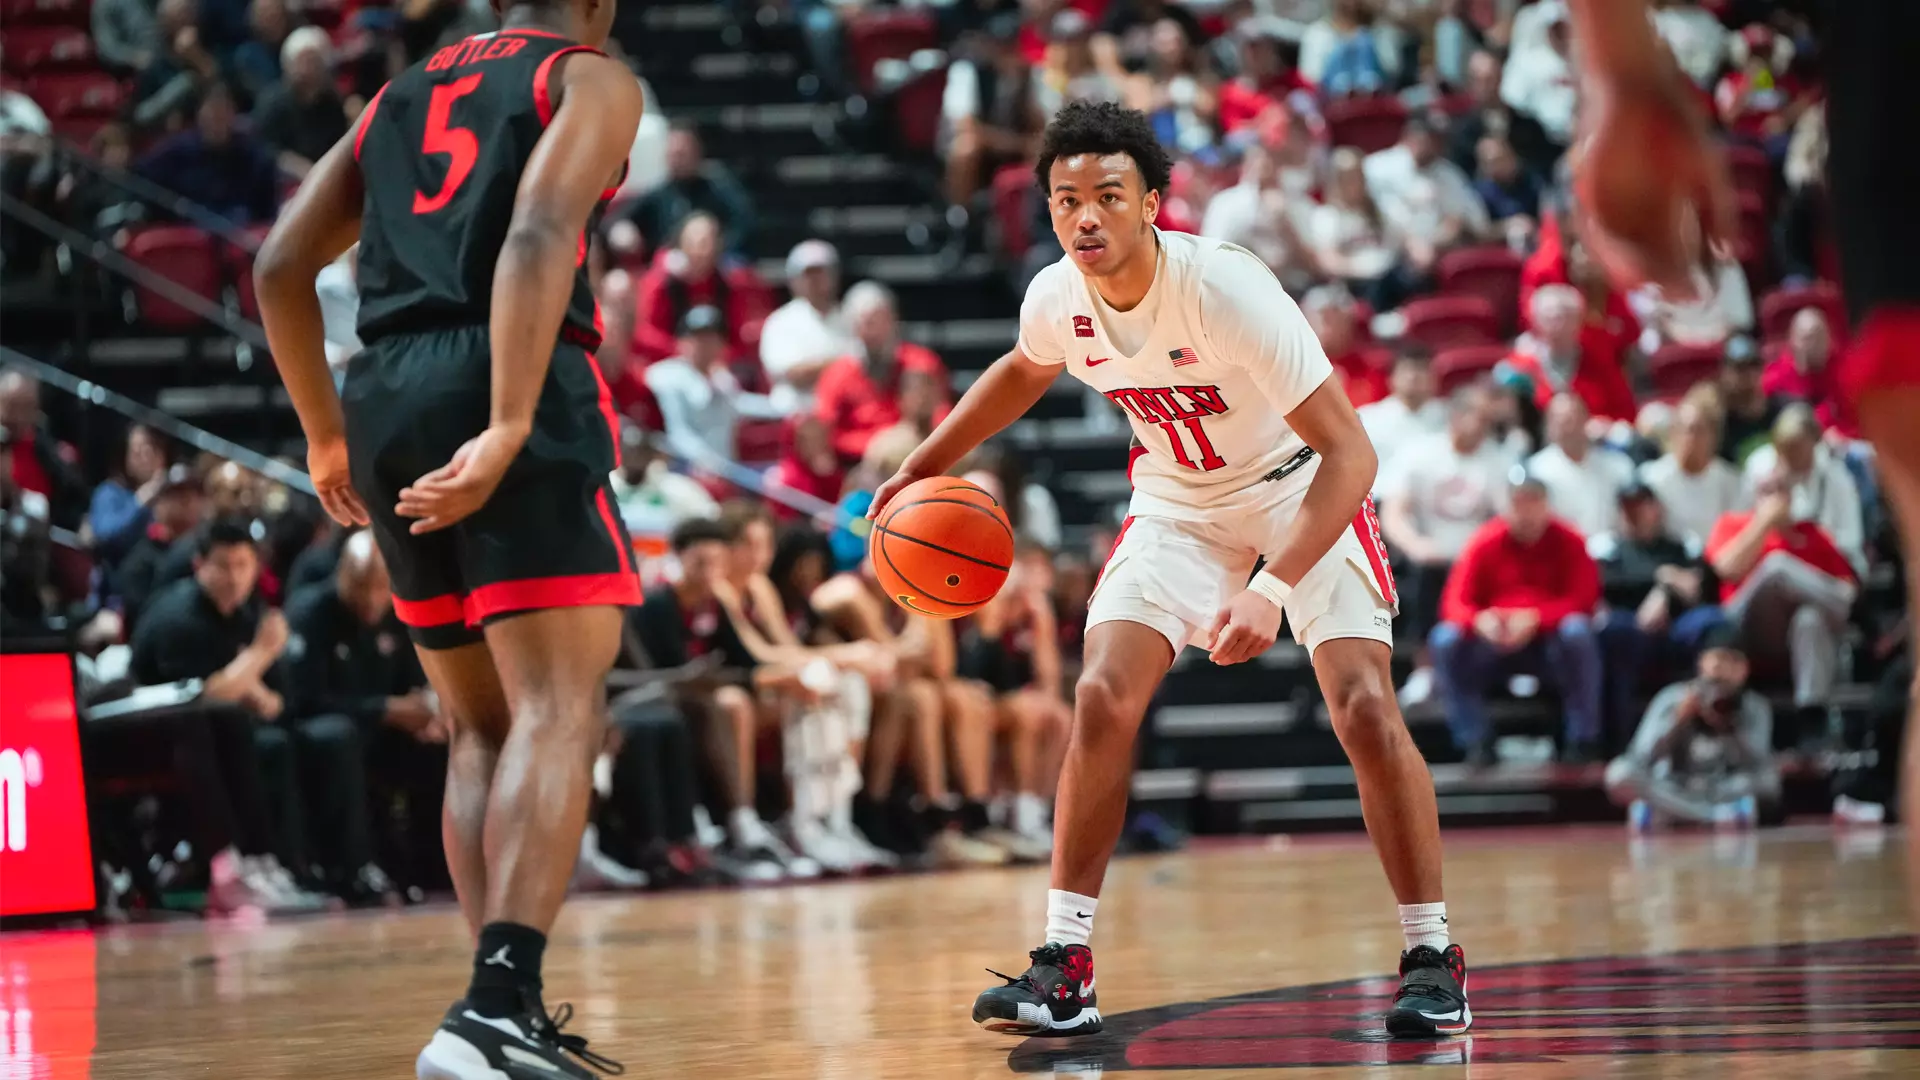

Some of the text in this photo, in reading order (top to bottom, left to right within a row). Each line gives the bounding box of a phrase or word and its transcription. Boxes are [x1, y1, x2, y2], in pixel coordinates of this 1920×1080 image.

[424, 37, 528, 72] BUTLER
[412, 72, 484, 215] 5
[1159, 418, 1227, 472] 11
